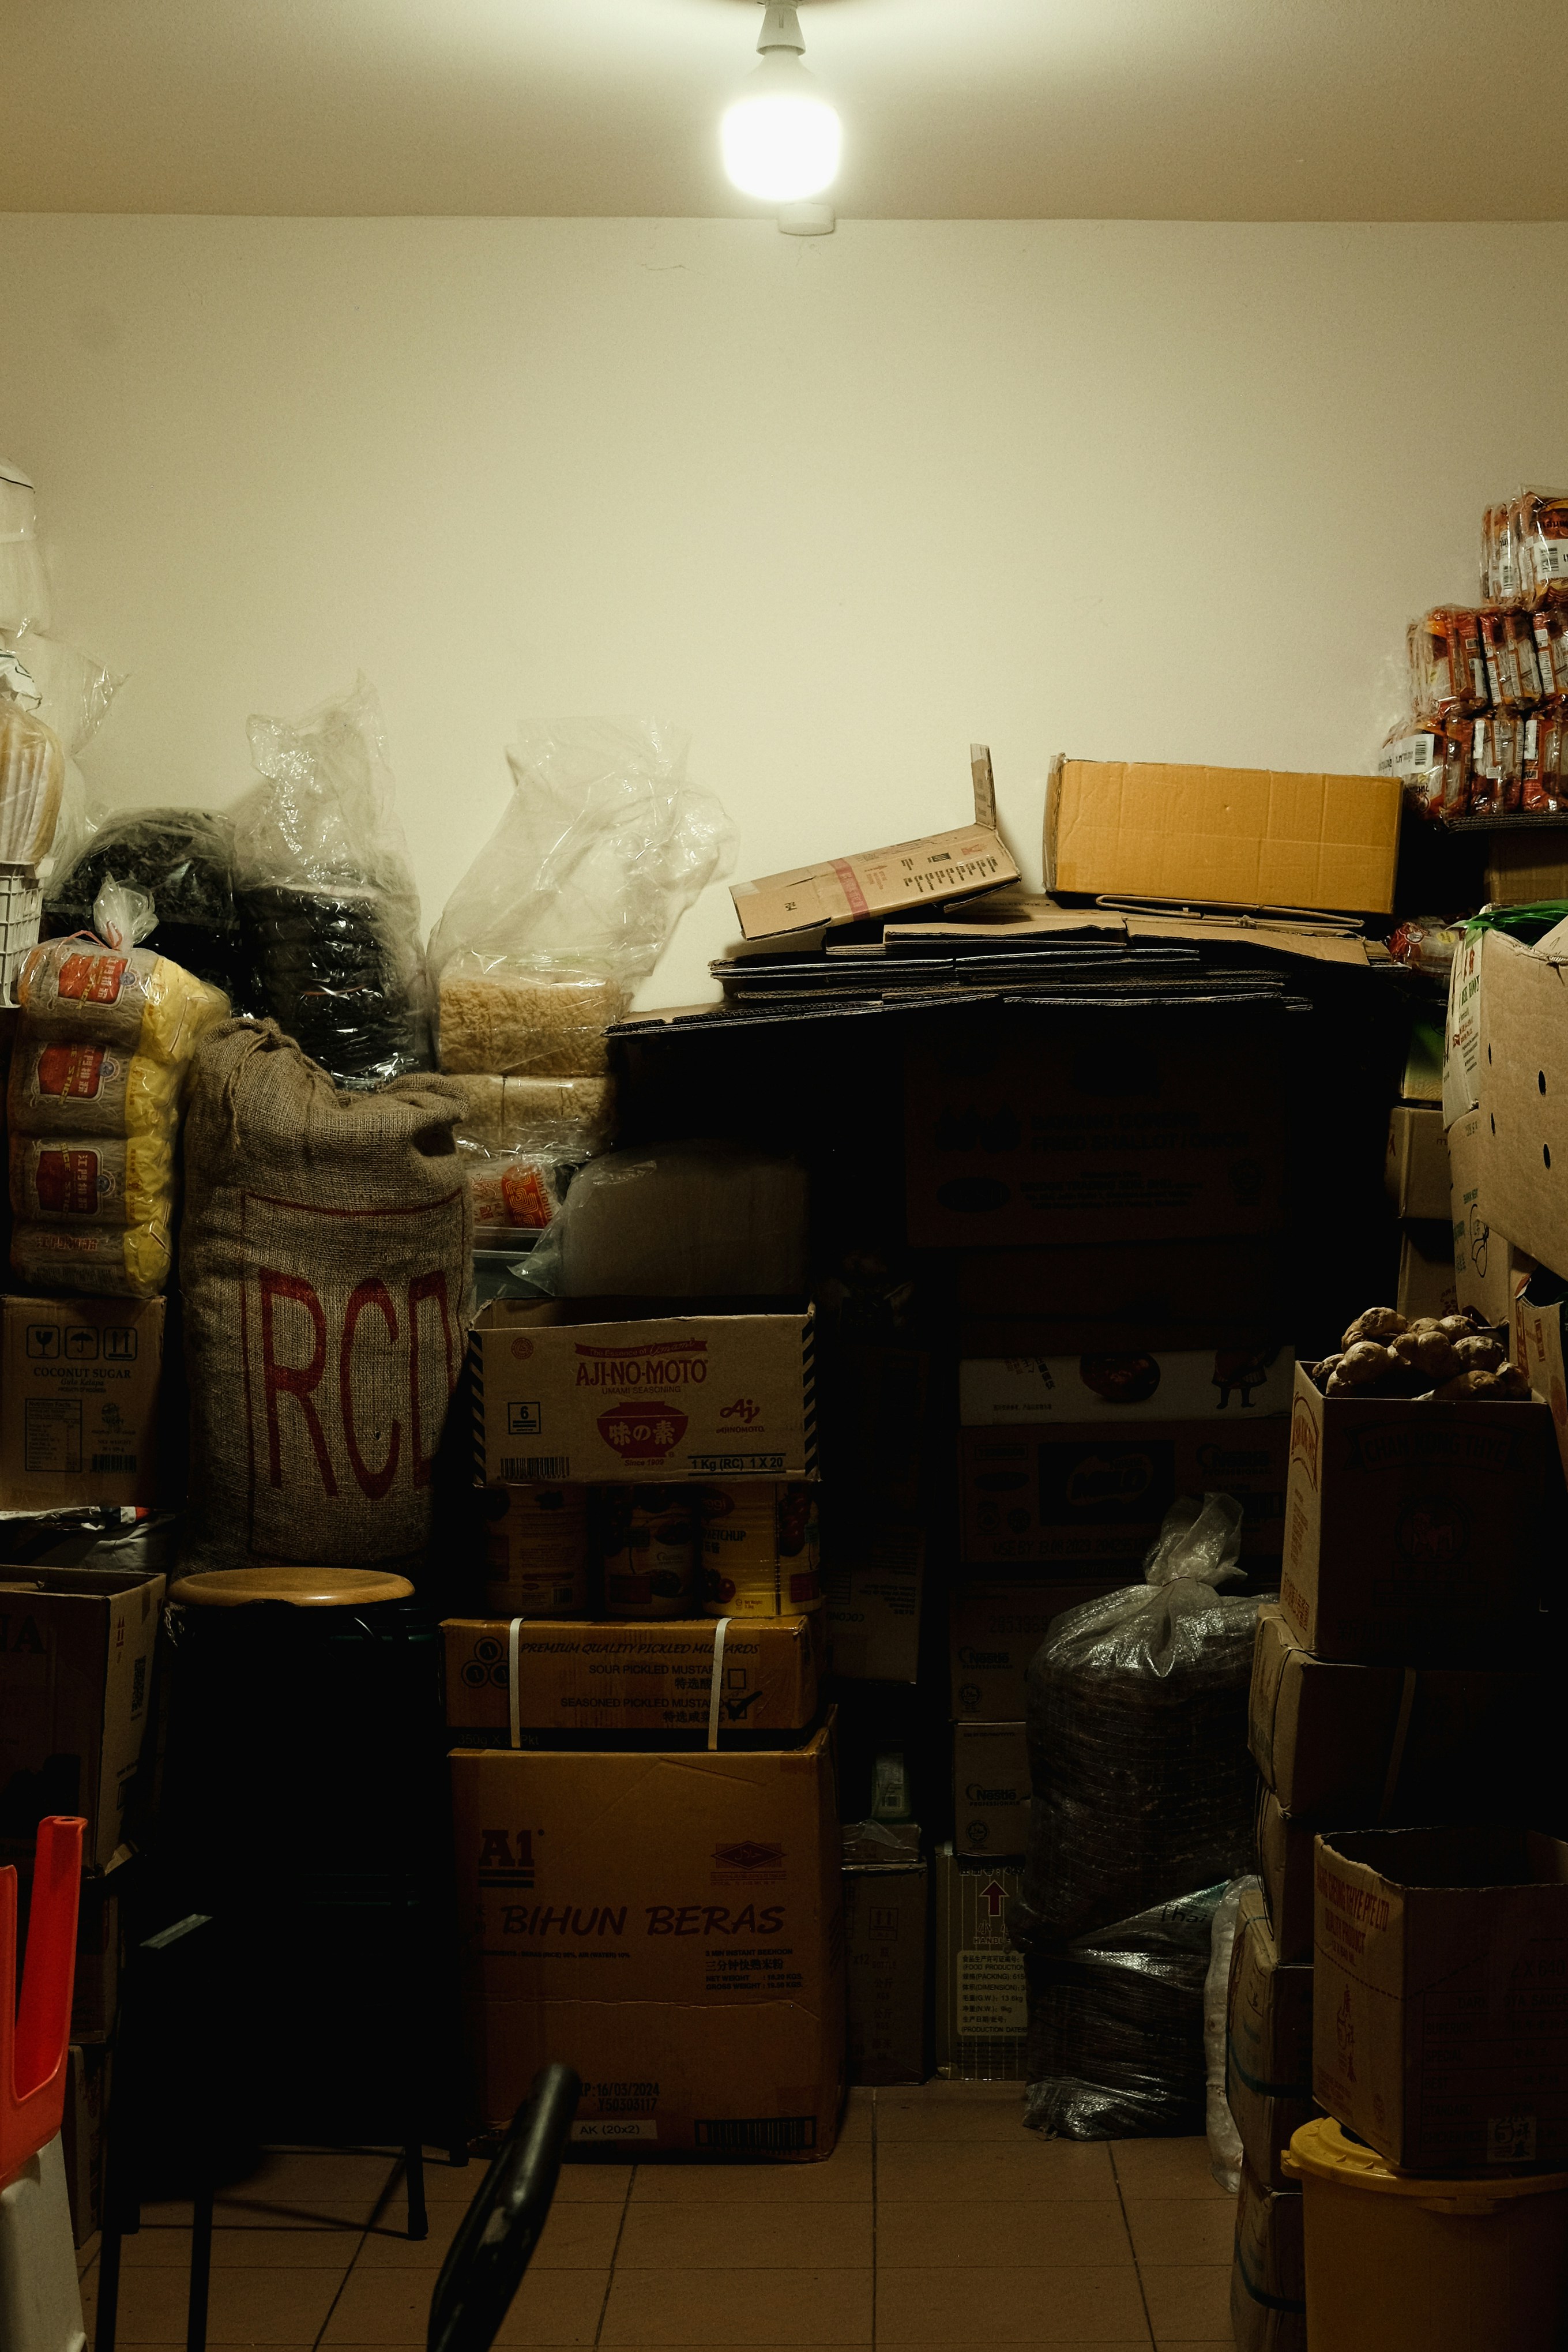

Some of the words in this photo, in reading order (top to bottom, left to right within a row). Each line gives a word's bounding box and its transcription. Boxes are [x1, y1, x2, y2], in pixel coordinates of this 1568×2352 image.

[1031, 1134, 1086, 1152] FRIED
[33, 1367, 89, 1378] COCONUT
[92, 1369, 131, 1379] SUGAR
[601, 1387, 630, 1395] UMAMI
[632, 1385, 682, 1394] SEASONING
[520, 1406, 529, 1420] 6
[608, 1419, 676, 1446] 味の素
[716, 1426, 765, 1434] AJINOMOTO
[692, 1459, 697, 1469] 1
[701, 1459, 717, 1471] Kg
[720, 1457, 744, 1471] (RC)
[750, 1458, 755, 1468] 1
[759, 1457, 768, 1468] X
[770, 1457, 783, 1467] 20
[520, 1643, 580, 1653] PREMIUM
[581, 1643, 636, 1655] QUALITY
[637, 1643, 691, 1654] PICKLED
[589, 1664, 620, 1674] SOUR
[623, 1665, 669, 1674] PICKLED
[561, 1697, 621, 1708] SEASONED
[623, 1698, 669, 1708] PICKLED
[457, 1734, 488, 1747] 350g
[492, 1734, 501, 1745] X
[478, 1829, 535, 1868] A1
[501, 1904, 629, 1936] BIHUN
[645, 1903, 785, 1936] BERAS
[1426, 2022, 1472, 2035] SUPERIOR
[1425, 2049, 1464, 2062] SPECIAL
[1424, 2076, 1449, 2090] BEST
[1424, 2103, 1473, 2118] STANDARD
[580, 2125, 598, 2135] AK
[602, 2124, 640, 2135] (20x2)
